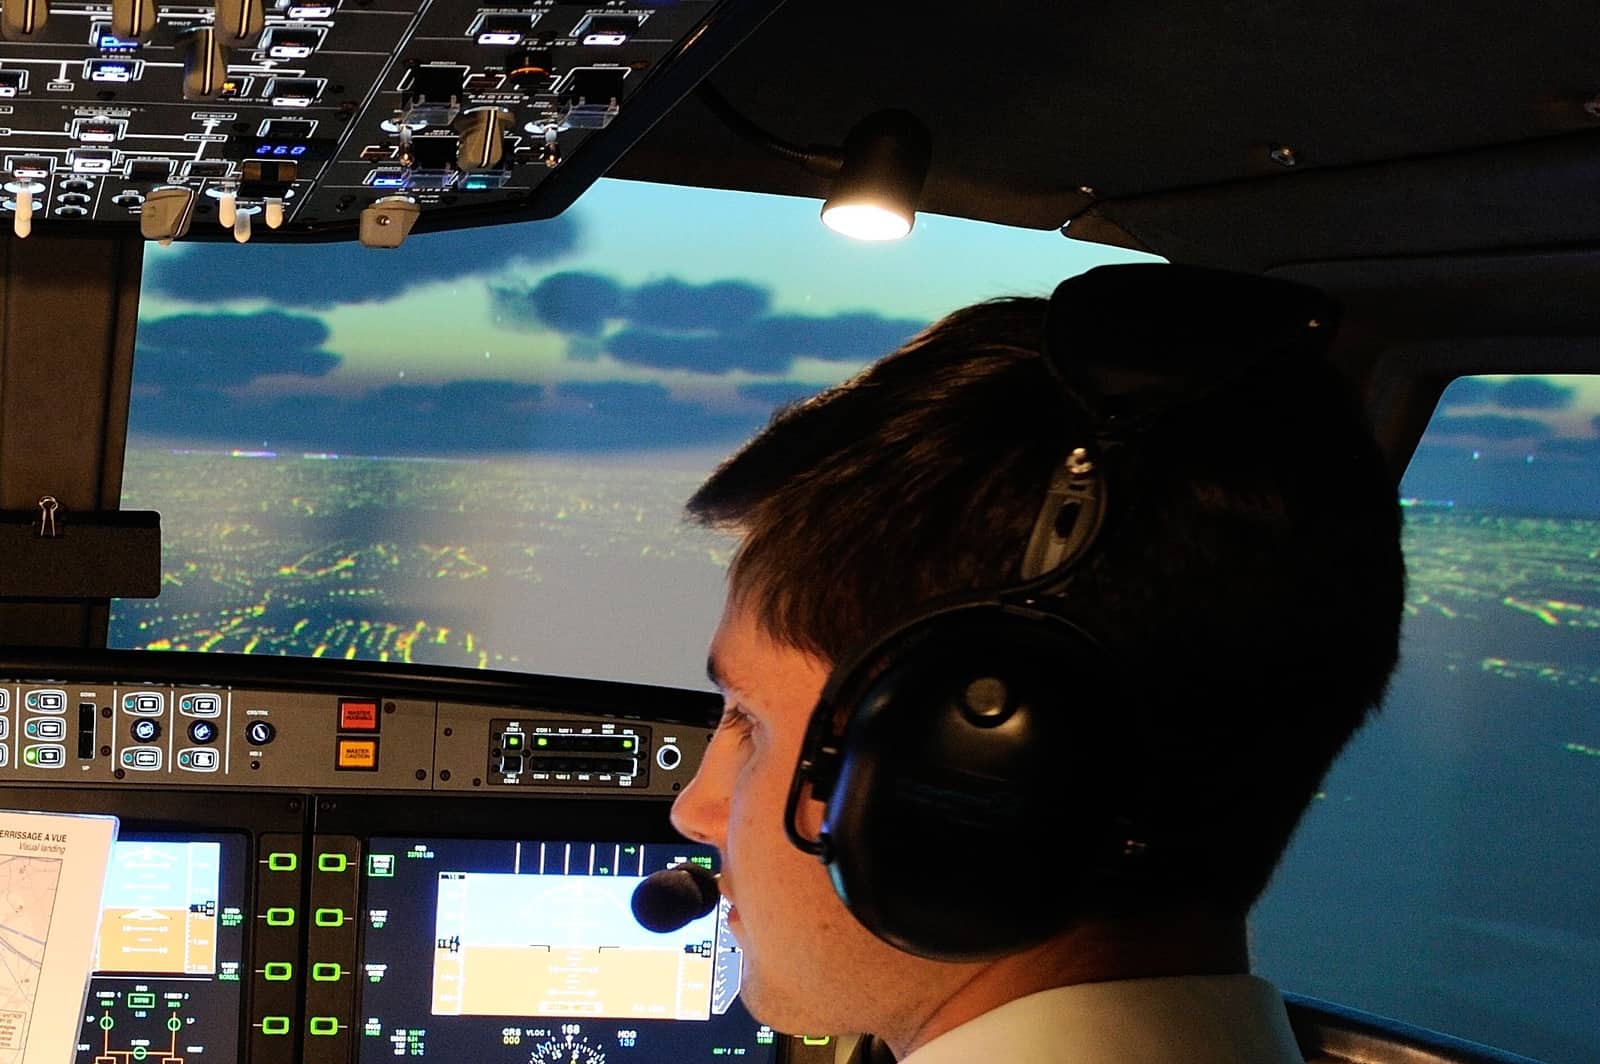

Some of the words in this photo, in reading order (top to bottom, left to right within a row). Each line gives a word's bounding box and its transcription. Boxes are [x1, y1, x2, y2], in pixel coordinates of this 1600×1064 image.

[51, 834, 67, 842] VUE
[19, 842, 40, 852] Visual
[41, 844, 66, 855] landing
[502, 1028, 521, 1036] CRS
[561, 1024, 581, 1034] 168
[618, 1030, 637, 1038] HDG
[503, 1036, 520, 1044] 000
[619, 1039, 635, 1047] 139
